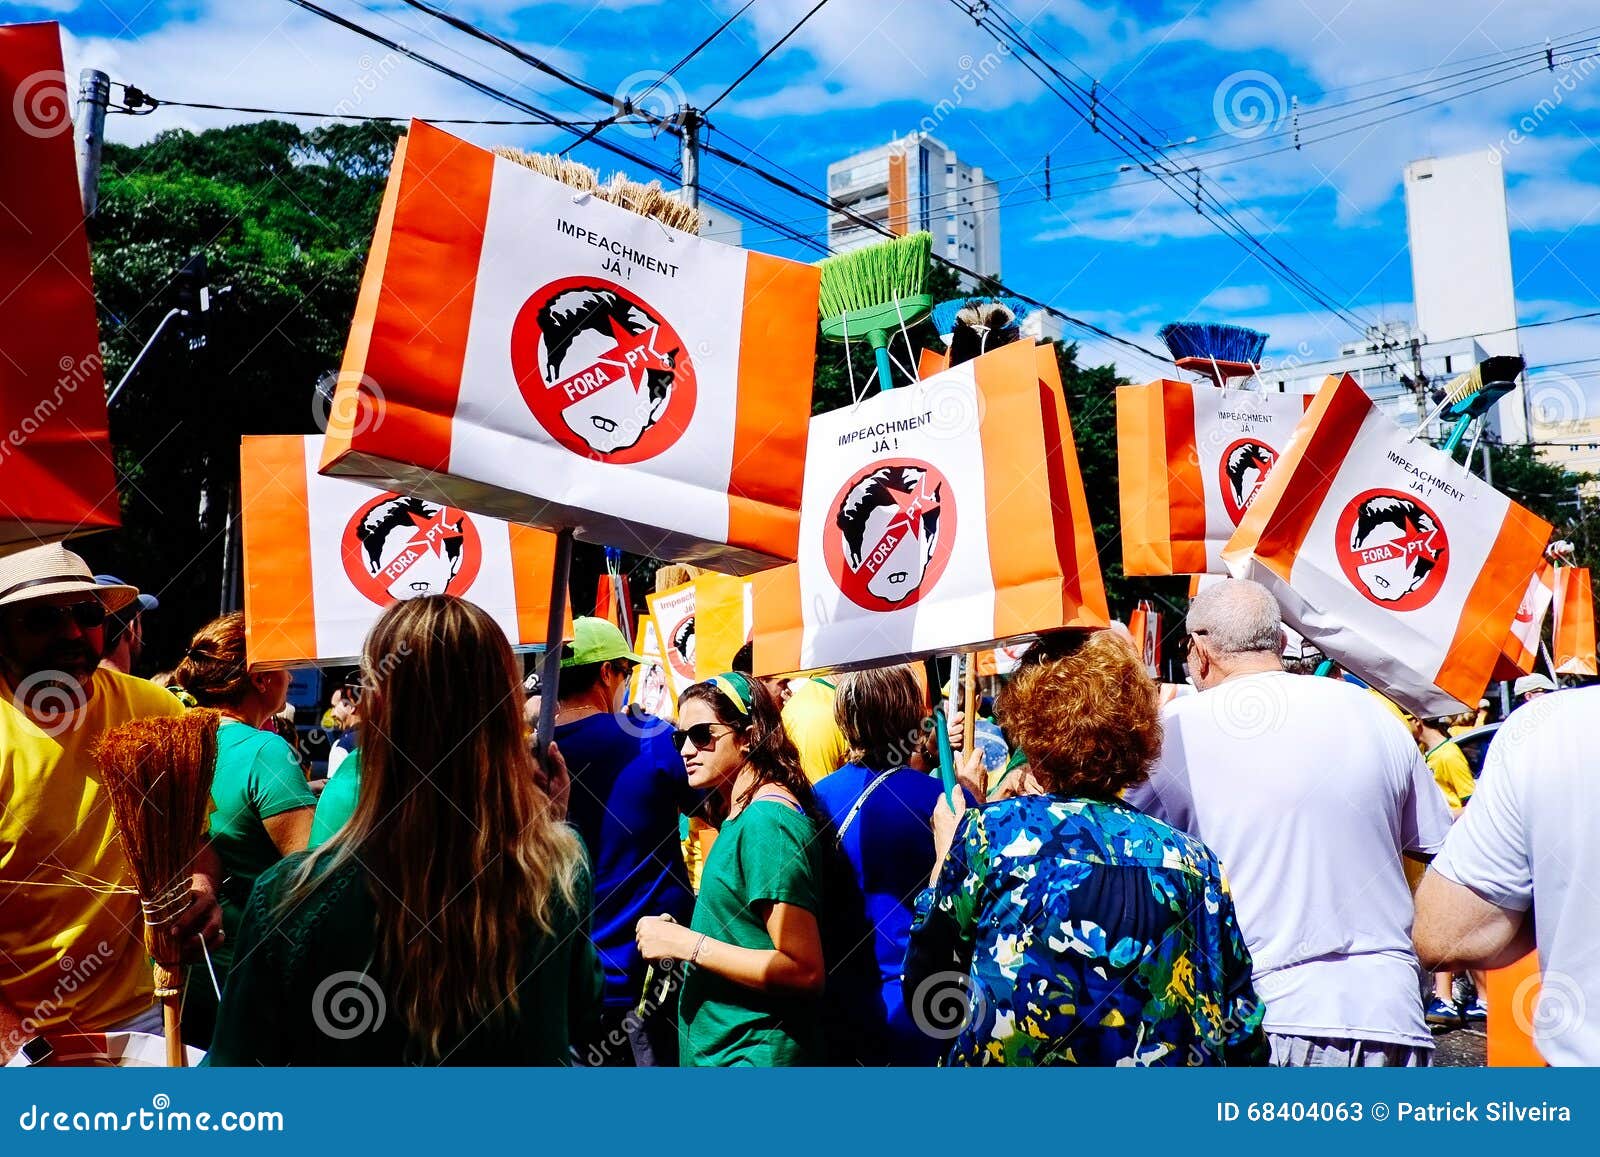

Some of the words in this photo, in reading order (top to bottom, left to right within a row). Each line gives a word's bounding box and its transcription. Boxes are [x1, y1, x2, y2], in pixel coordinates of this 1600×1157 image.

[557, 219, 679, 278] IMPEACHMENT
[602, 258, 622, 276] JÁ
[563, 368, 610, 401] FORA
[625, 345, 649, 369] PT
[838, 411, 933, 446] IMPEACHMENT
[1217, 411, 1273, 423] IMPEACHMENT
[1240, 423, 1250, 433] JÁ
[872, 437, 890, 453] JÁ
[1387, 451, 1465, 502] IMPEACHMENT
[1409, 481, 1424, 493] JÁ
[866, 536, 898, 573] FORA
[906, 499, 925, 521] PT
[385, 549, 419, 580] FORA
[425, 523, 445, 542] PT
[1361, 547, 1393, 564] FORA
[1407, 540, 1424, 554] PT
